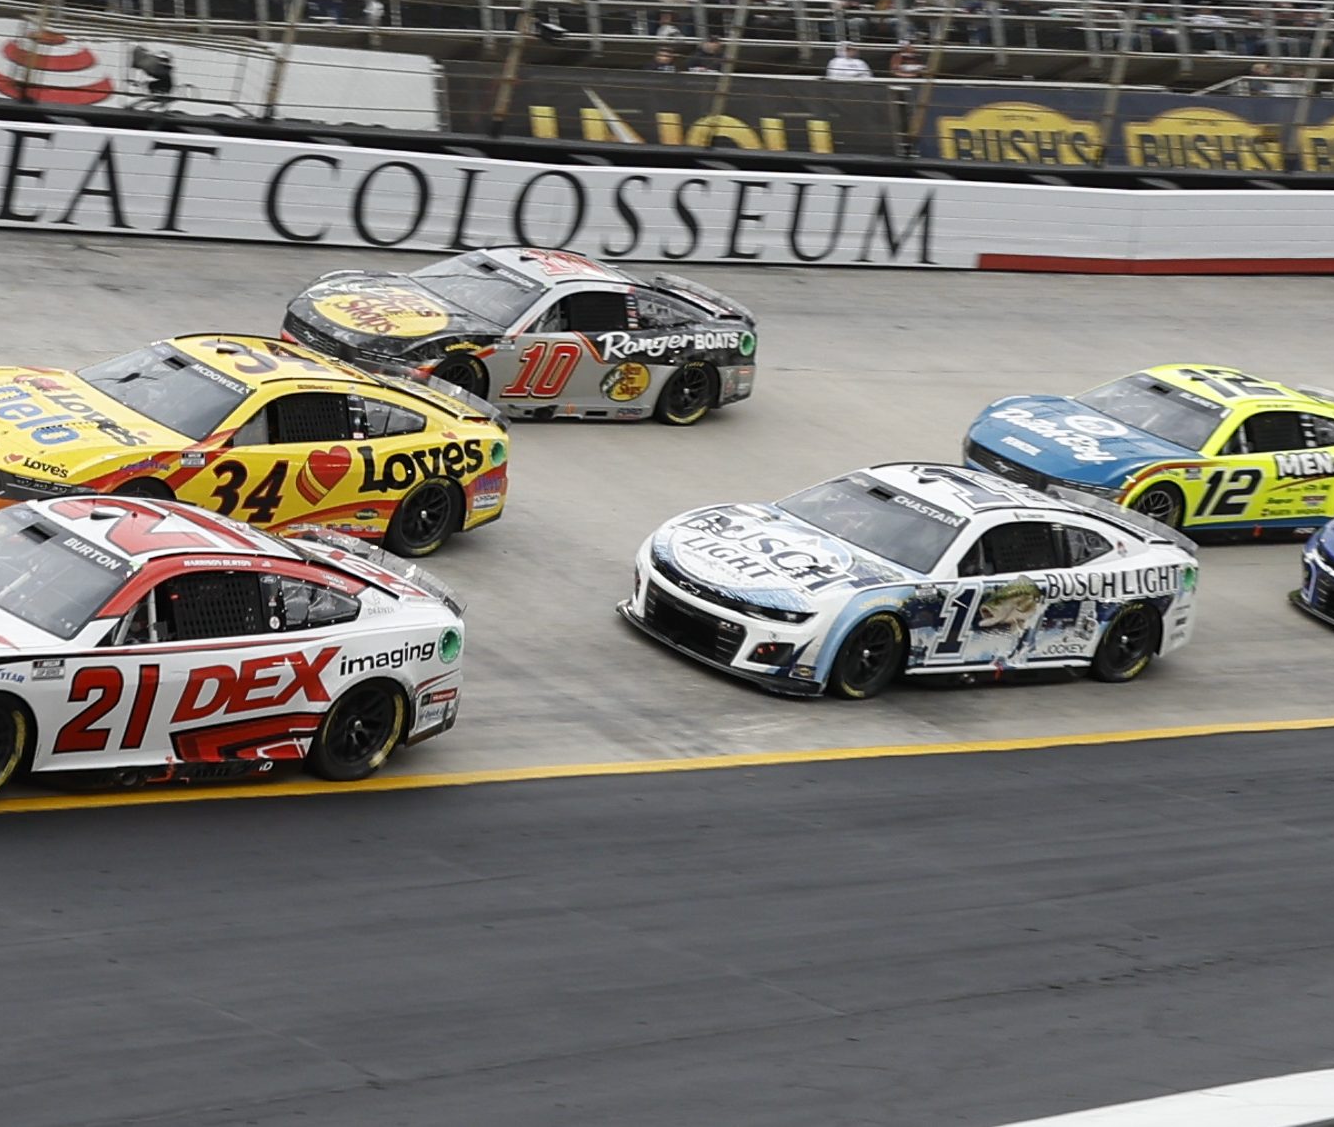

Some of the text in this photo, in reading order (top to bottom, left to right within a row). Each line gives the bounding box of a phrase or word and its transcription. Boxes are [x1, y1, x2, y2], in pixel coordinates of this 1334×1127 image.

[266, 154, 938, 265] COLOSSEUM
[597, 331, 738, 361] Ranger BOATS
[192, 362, 247, 395] MCDOWELL
[500, 342, 582, 399] 10
[211, 460, 290, 523] 34
[894, 494, 961, 527] CHASTAIN
[1193, 469, 1262, 517] 12
[64, 538, 121, 570] BURTON
[683, 537, 776, 578] LIGHT
[1045, 566, 1179, 600] BUSCH LIGHT
[933, 588, 976, 655] 1
[340, 641, 436, 676] imaging
[170, 646, 342, 724] DEX
[52, 665, 160, 754] 21
